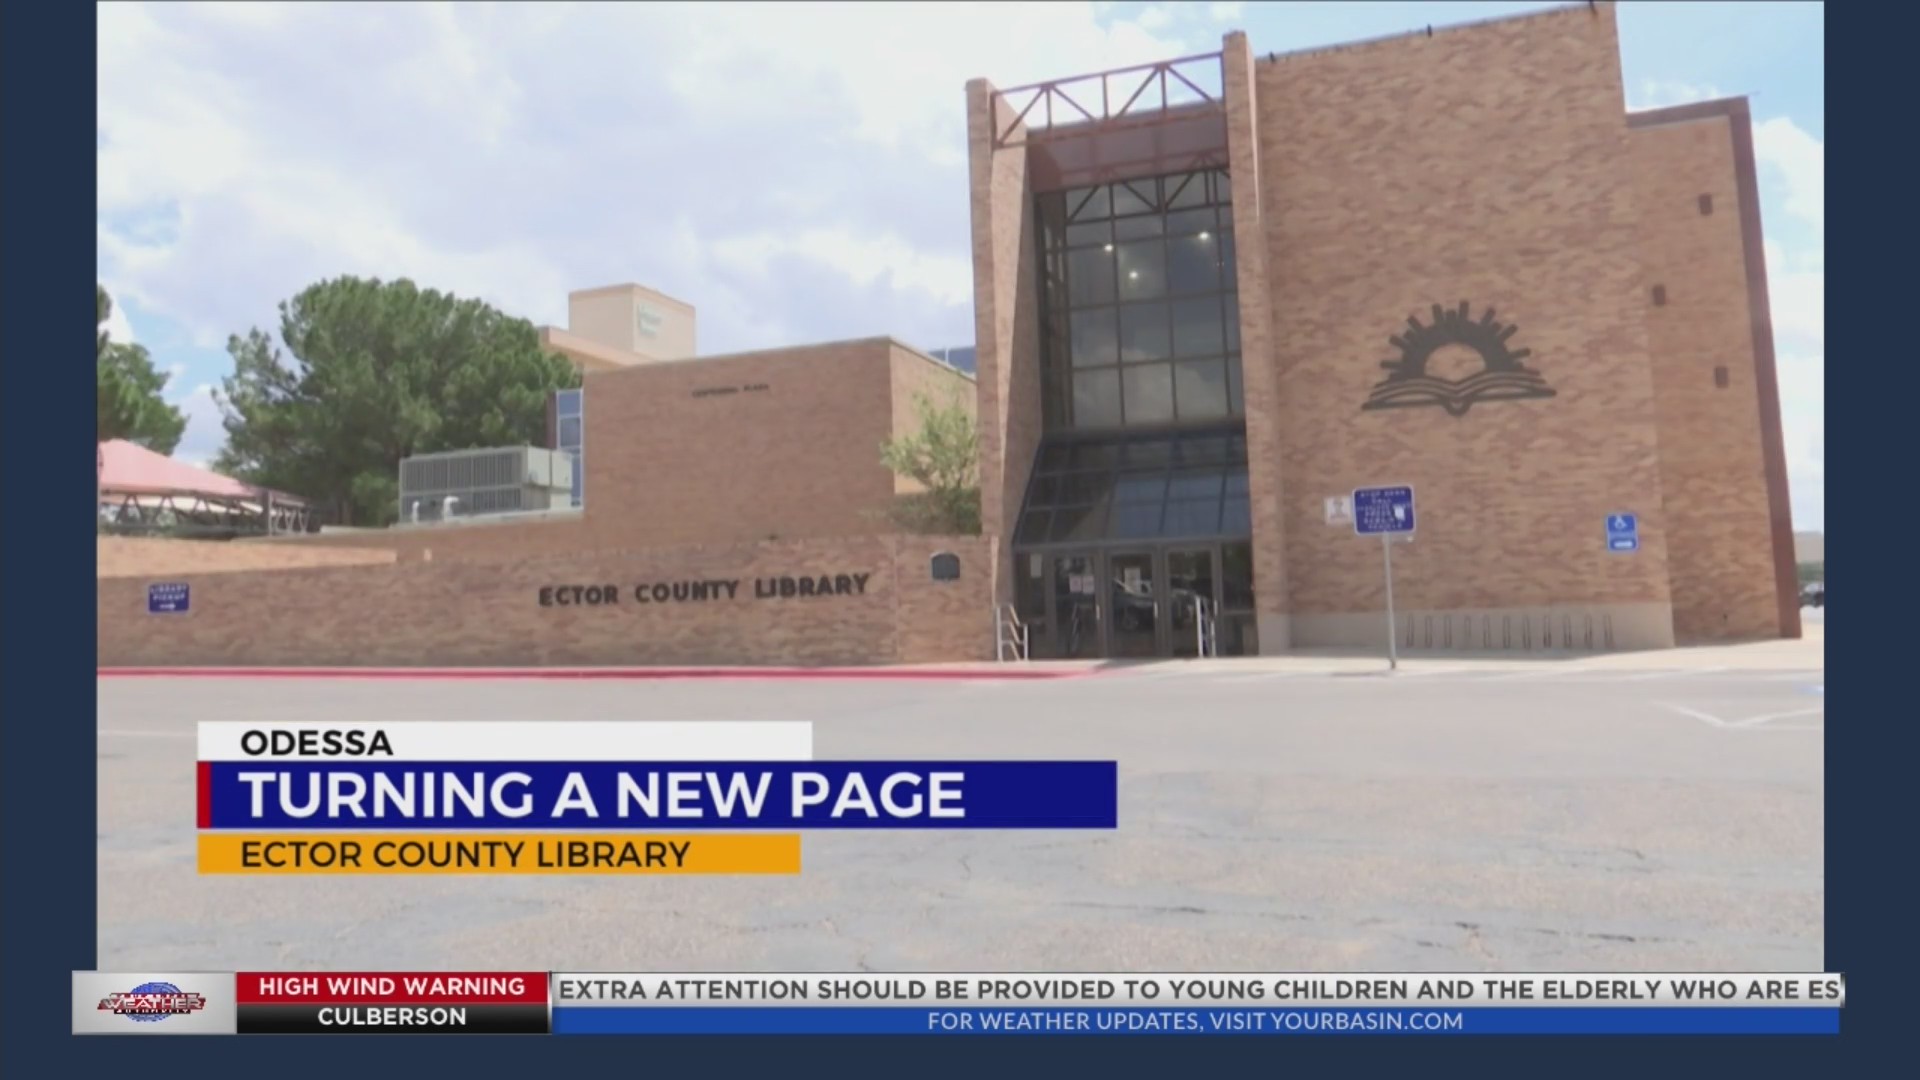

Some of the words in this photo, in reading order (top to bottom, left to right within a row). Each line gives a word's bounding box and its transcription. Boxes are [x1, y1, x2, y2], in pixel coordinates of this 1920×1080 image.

[538, 584, 619, 607] ECTOR
[634, 580, 740, 603] COUNTY
[754, 572, 871, 599] LIBRARY
